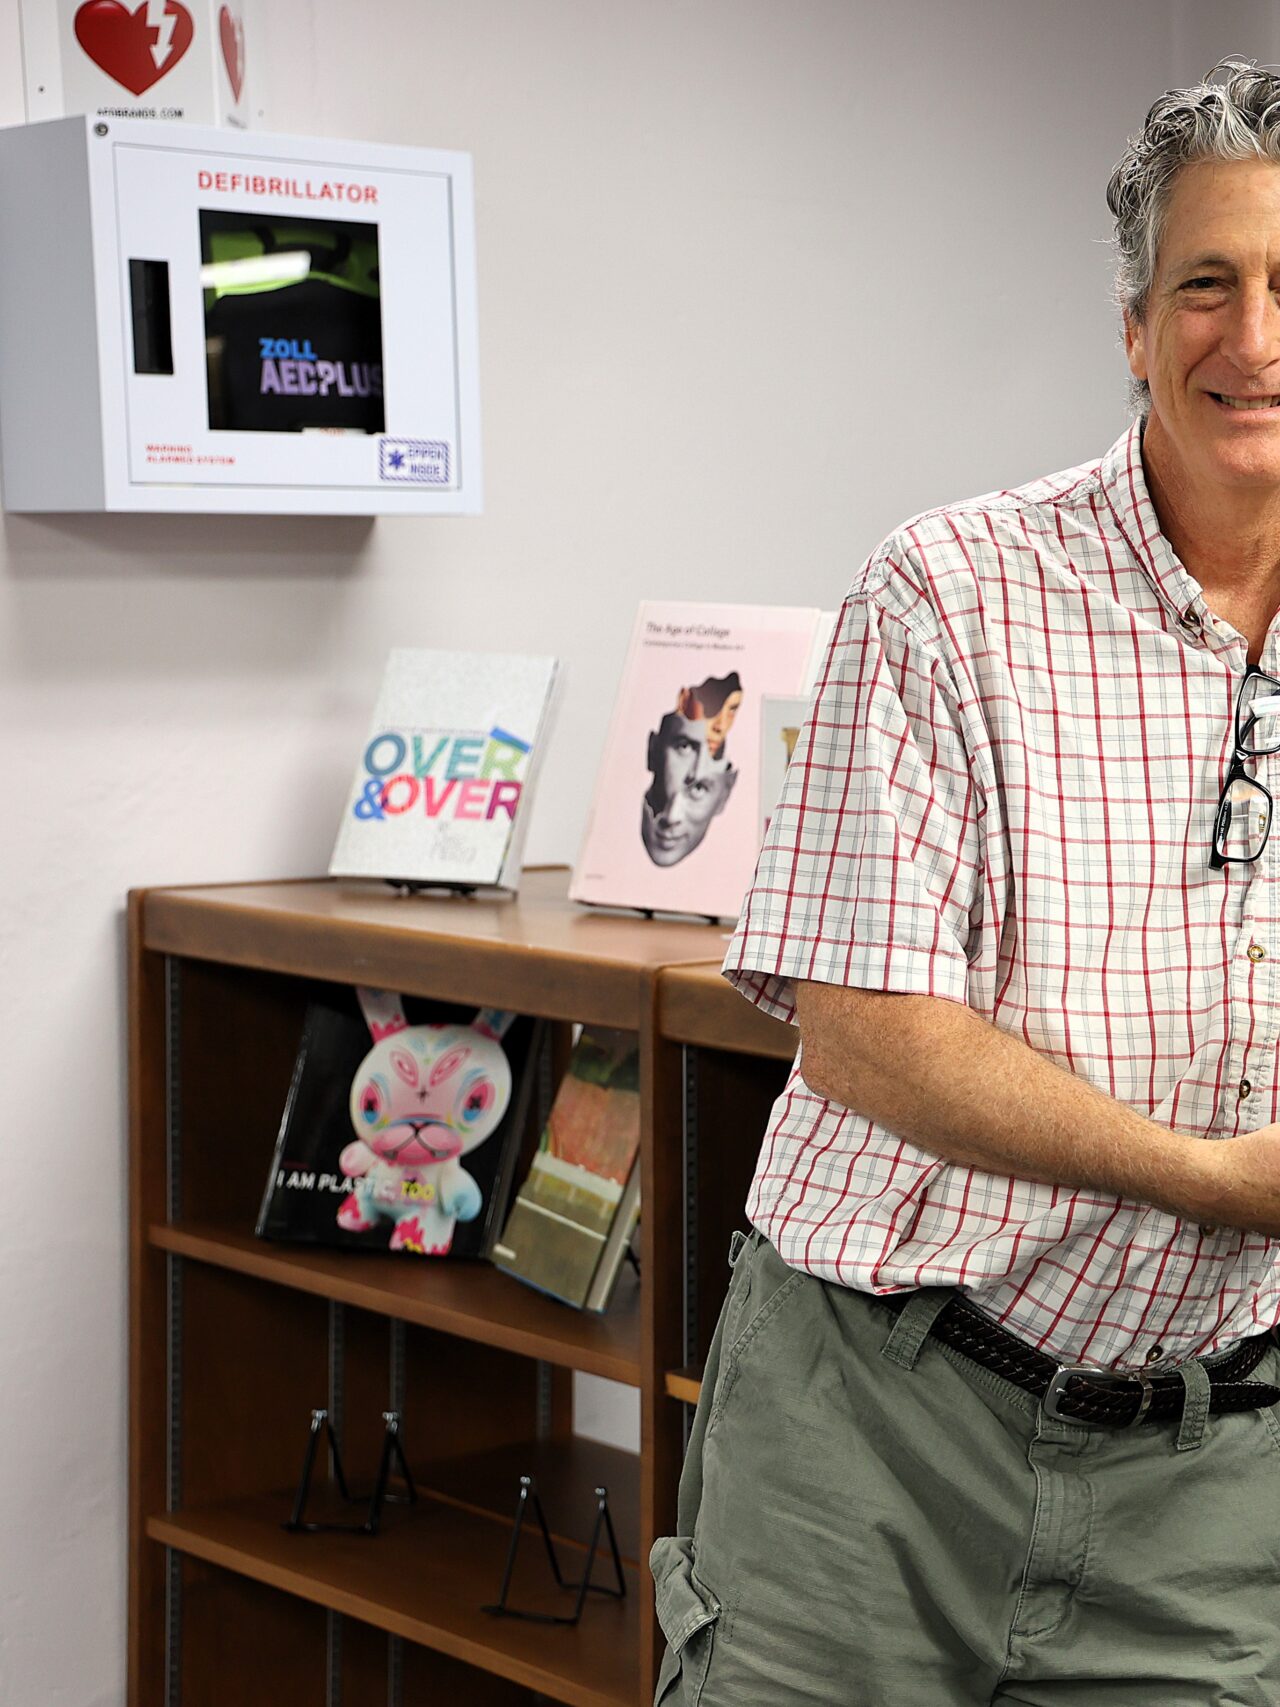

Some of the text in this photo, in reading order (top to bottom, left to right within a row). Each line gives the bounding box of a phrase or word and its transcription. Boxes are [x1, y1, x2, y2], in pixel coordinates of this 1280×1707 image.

[197, 170, 379, 204] DEFIBRILLATOR
[258, 337, 317, 360] ZOLL
[647, 622, 661, 632] The
[666, 623, 682, 637] Age
[364, 731, 524, 781] OVER
[277, 1169, 285, 1187] I
[287, 1171, 315, 1190] AM
[402, 1179, 436, 1200] TOO
